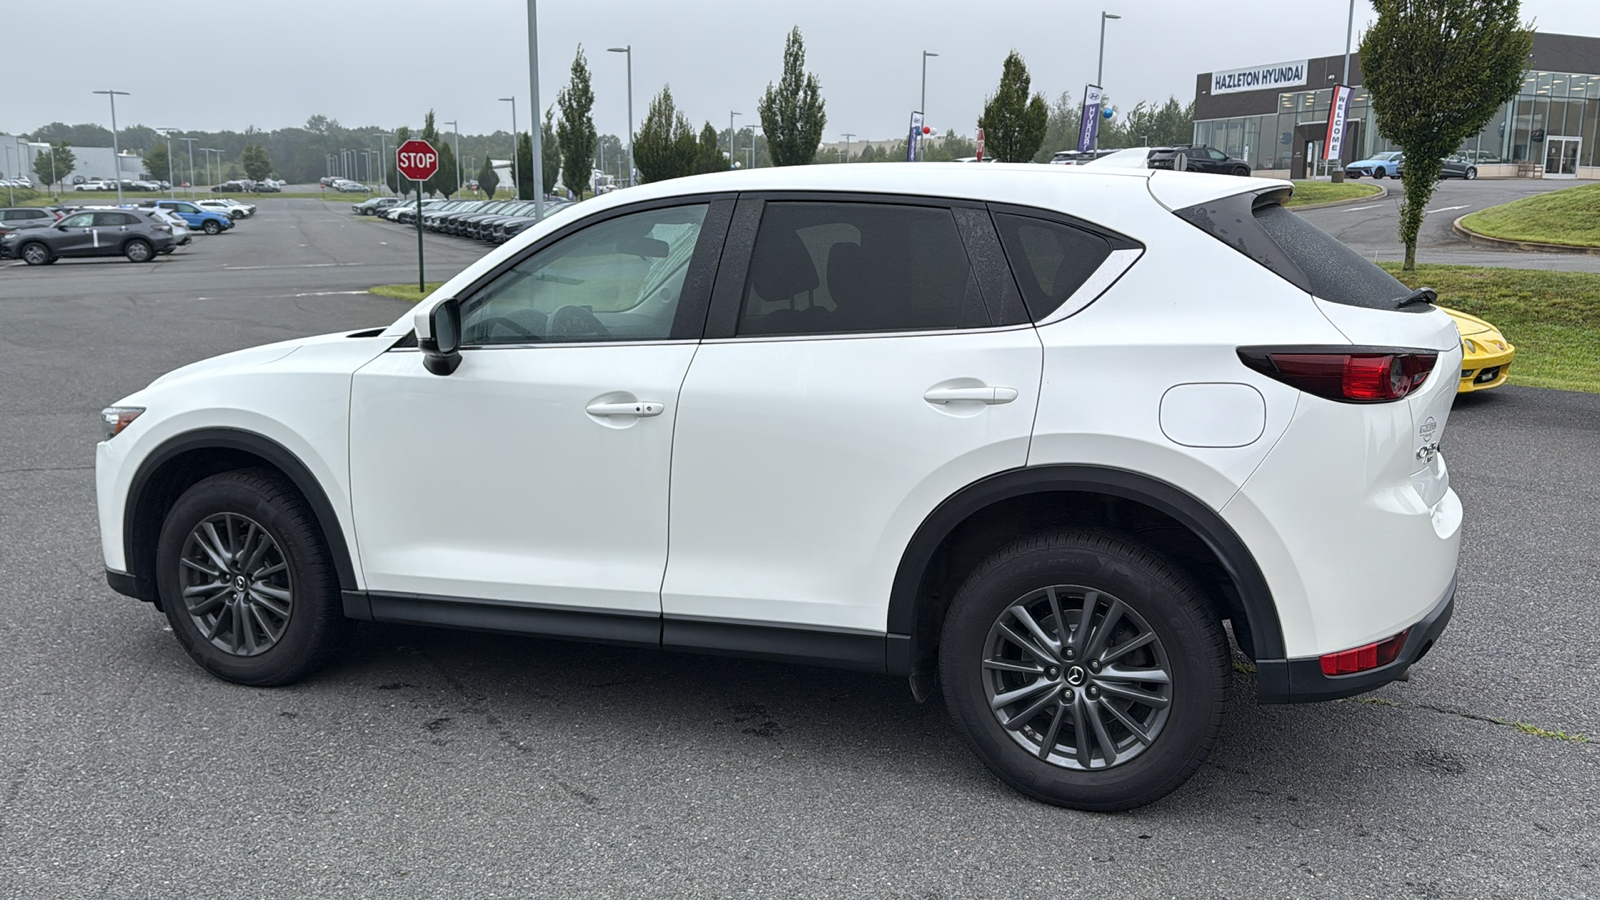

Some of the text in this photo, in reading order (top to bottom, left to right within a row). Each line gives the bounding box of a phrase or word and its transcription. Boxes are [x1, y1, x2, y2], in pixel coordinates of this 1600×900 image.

[1214, 64, 1304, 90] HAZLETON HYUNDAI
[1083, 106, 1096, 151] HYUNDAI
[1331, 95, 1346, 152] WELCOME
[399, 152, 436, 169] STOP
